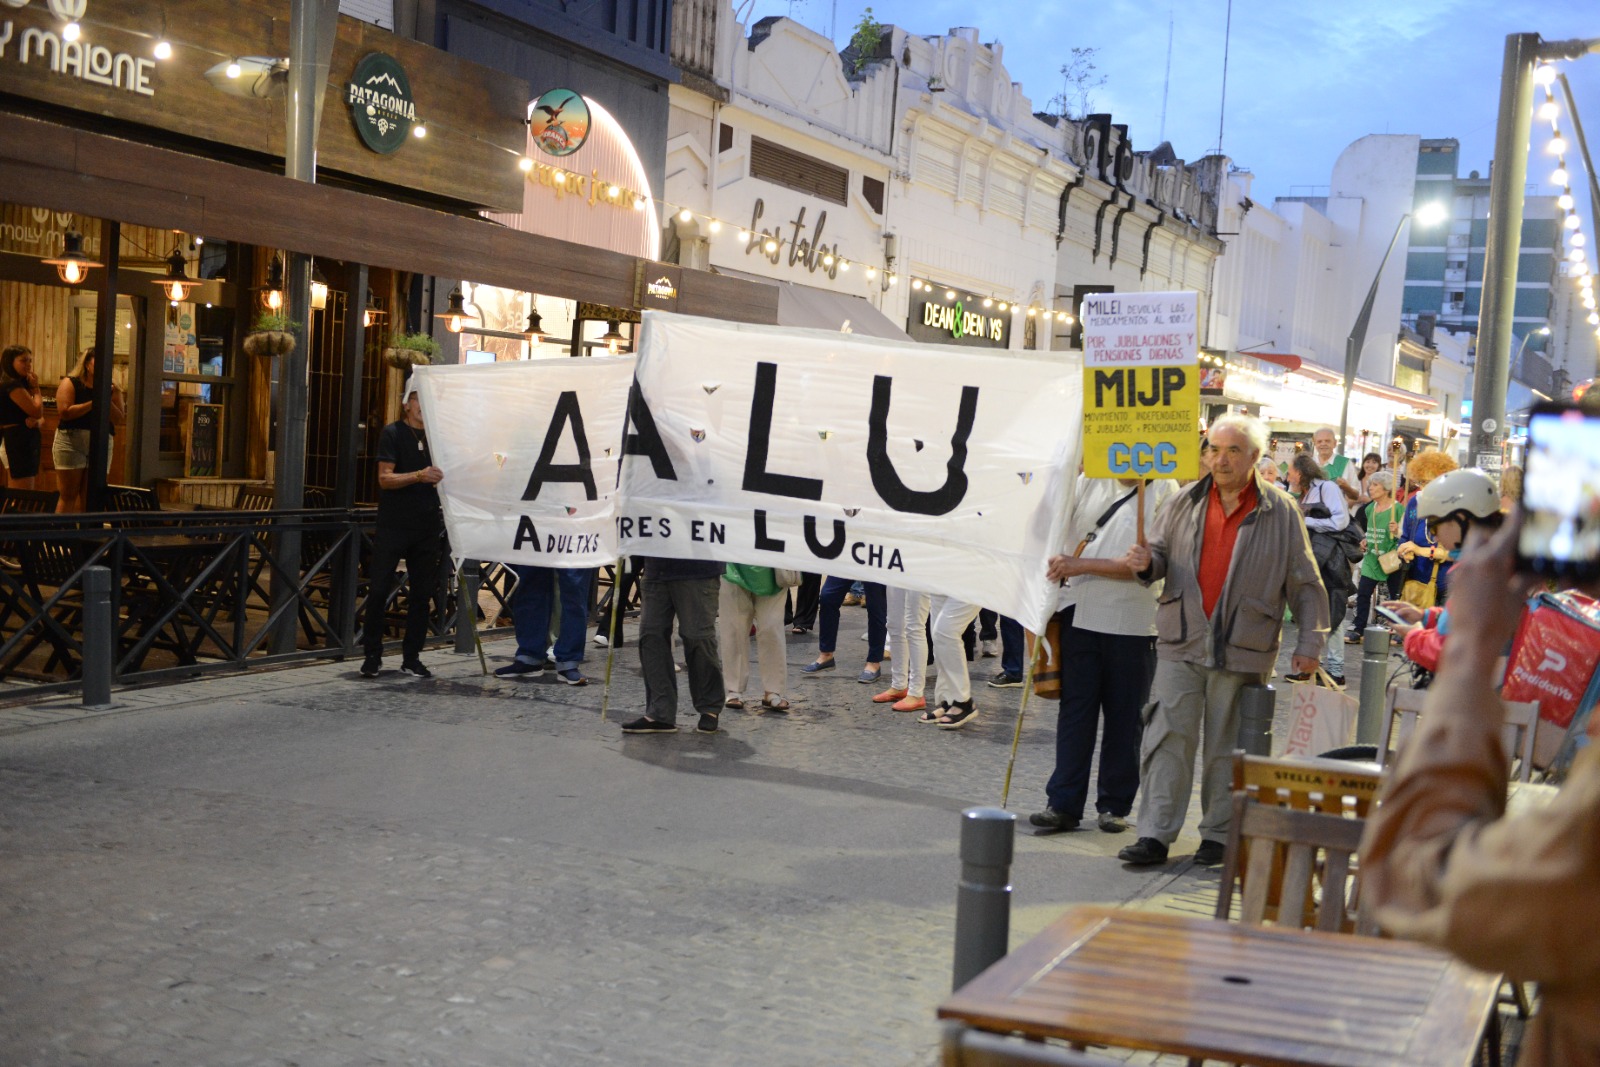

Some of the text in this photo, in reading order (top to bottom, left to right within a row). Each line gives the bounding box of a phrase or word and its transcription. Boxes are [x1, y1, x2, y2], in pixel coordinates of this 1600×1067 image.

[349, 83, 416, 122] PATAGONIA
[46, 231, 101, 256] MNE
[1087, 333, 1194, 348] POR JUBILACIONES Y
[1094, 347, 1184, 362] PENSIONES DIGNAS
[1095, 368, 1186, 408] MIJP
[1084, 410, 1191, 422] MOVIMIENTO INDEPENDIENTE
[1096, 423, 1133, 434] JUBILADOS
[1142, 422, 1192, 433] PENSIONADOS
[1108, 442, 1177, 474] CCC
[615, 516, 672, 539] RES
[691, 520, 725, 544] EN
[754, 509, 905, 572] LUCHA
[1512, 666, 1573, 701] PedidosYa
[1274, 770, 1377, 790] STELLA ARTO
